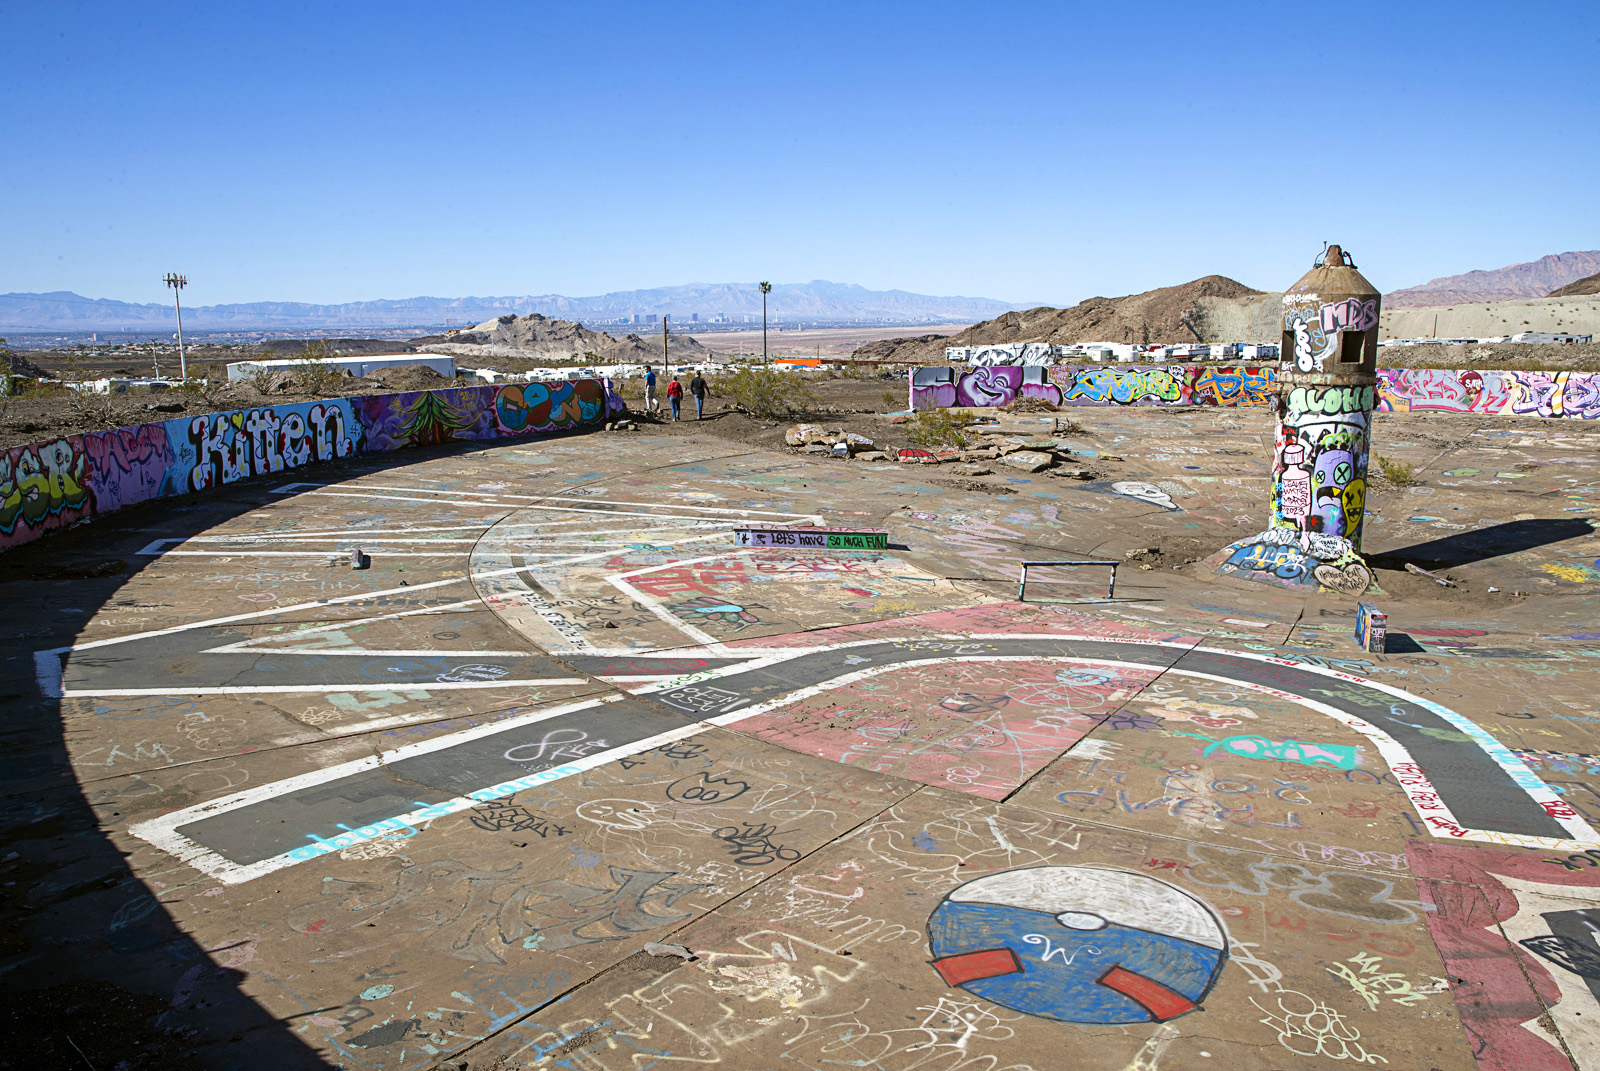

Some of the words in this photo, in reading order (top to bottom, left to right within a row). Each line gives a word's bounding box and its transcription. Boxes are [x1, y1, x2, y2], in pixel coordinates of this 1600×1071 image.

[189, 405, 353, 492] Kitten
[771, 533, 796, 545] Let's
[799, 534, 826, 546] have
[828, 536, 841, 546] SO
[843, 537, 864, 548] MUCH
[865, 536, 888, 549] FUN!
[472, 764, 586, 804] aaron
